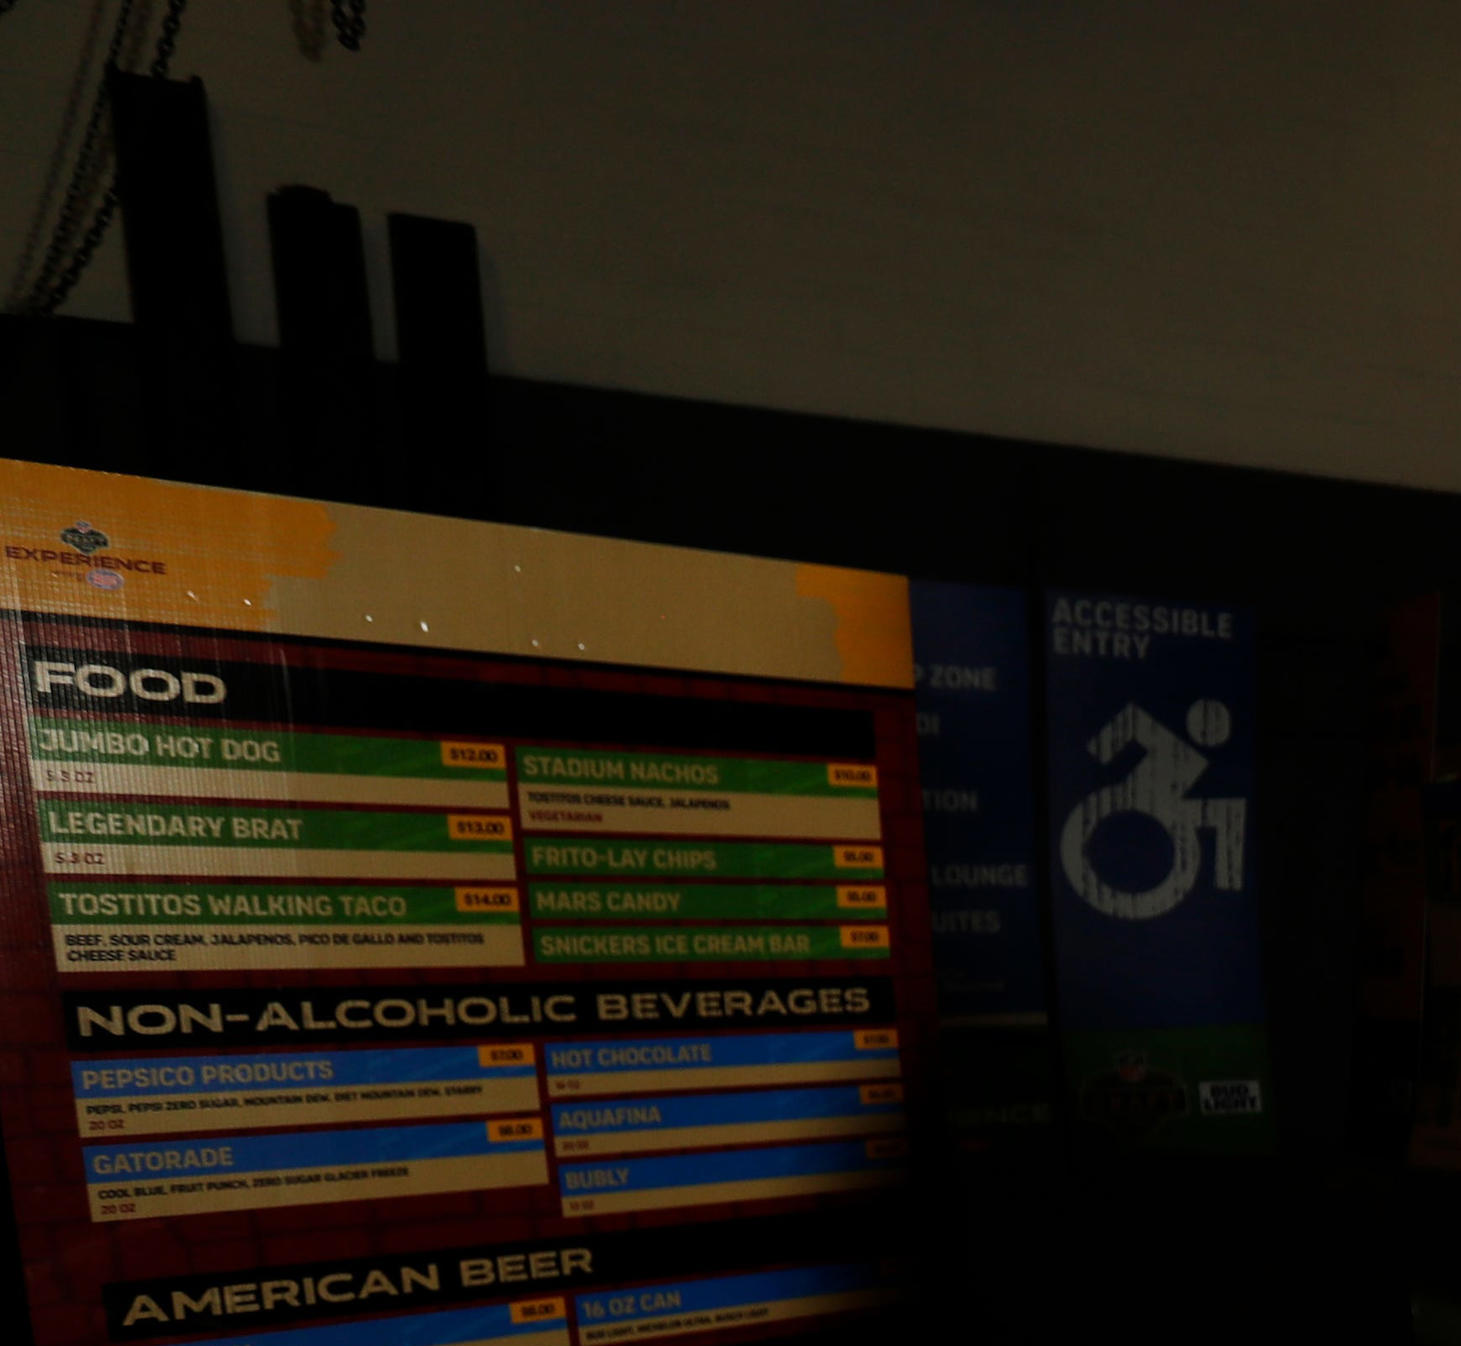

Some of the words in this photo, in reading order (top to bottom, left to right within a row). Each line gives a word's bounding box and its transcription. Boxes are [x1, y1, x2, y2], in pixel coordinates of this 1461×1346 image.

[5, 545, 167, 576] EXPERIENCE
[1051, 596, 1234, 640] ACCESSIBLE
[1052, 628, 1152, 661] ENTRY
[34, 660, 228, 705] FOOD
[930, 665, 997, 692] ZONE
[38, 728, 151, 756] JUMBO
[155, 734, 216, 760] HOT
[220, 738, 282, 764] DOG
[449, 747, 499, 764] $12.00
[523, 755, 626, 781] STADIUM
[630, 759, 720, 785] NACHOS
[49, 811, 227, 839] LEGENDARY
[232, 817, 305, 841] BRAT
[531, 845, 649, 869] FRITO-LAY
[653, 848, 718, 872] CHIPS
[930, 863, 1030, 888] LOUNGE
[59, 892, 203, 917] TOSTITOS
[207, 894, 335, 917] WALKING
[342, 895, 408, 918] TACO
[536, 890, 600, 912] MARS
[605, 889, 682, 913] CANDY
[931, 909, 1001, 936] UITES
[110, 933, 151, 948] SOUR
[299, 934, 330, 947] PICO
[333, 934, 350, 947] DE
[353, 934, 395, 946] GALLO
[397, 934, 424, 946] AND
[540, 934, 650, 957] SNICKERS
[654, 935, 691, 955] ICE
[693, 934, 766, 955] CREAM
[769, 933, 811, 954] BAR
[66, 949, 125, 964] CHEESE
[128, 949, 176, 963] SAUCE
[76, 993, 578, 1039] NON-ALCOHOLIC
[596, 985, 872, 1023] BEVERAGES
[551, 1046, 594, 1069] HOT
[598, 1042, 713, 1067] CHOCOLATE
[82, 1067, 195, 1092] PEPSICO
[202, 1060, 334, 1084] PRODUCTS
[166, 1099, 197, 1111] ZERO
[558, 1104, 662, 1130] AQUAFINA
[93, 1146, 234, 1176] GATORADE
[564, 1168, 630, 1190] BUBLY
[98, 1187, 131, 1199] COOL
[122, 1262, 441, 1328] AMERICAN
[458, 1248, 595, 1288] BEER
[580, 1300, 605, 1321] 16
[608, 1295, 636, 1317] OZ
[639, 1289, 682, 1312] CAN
